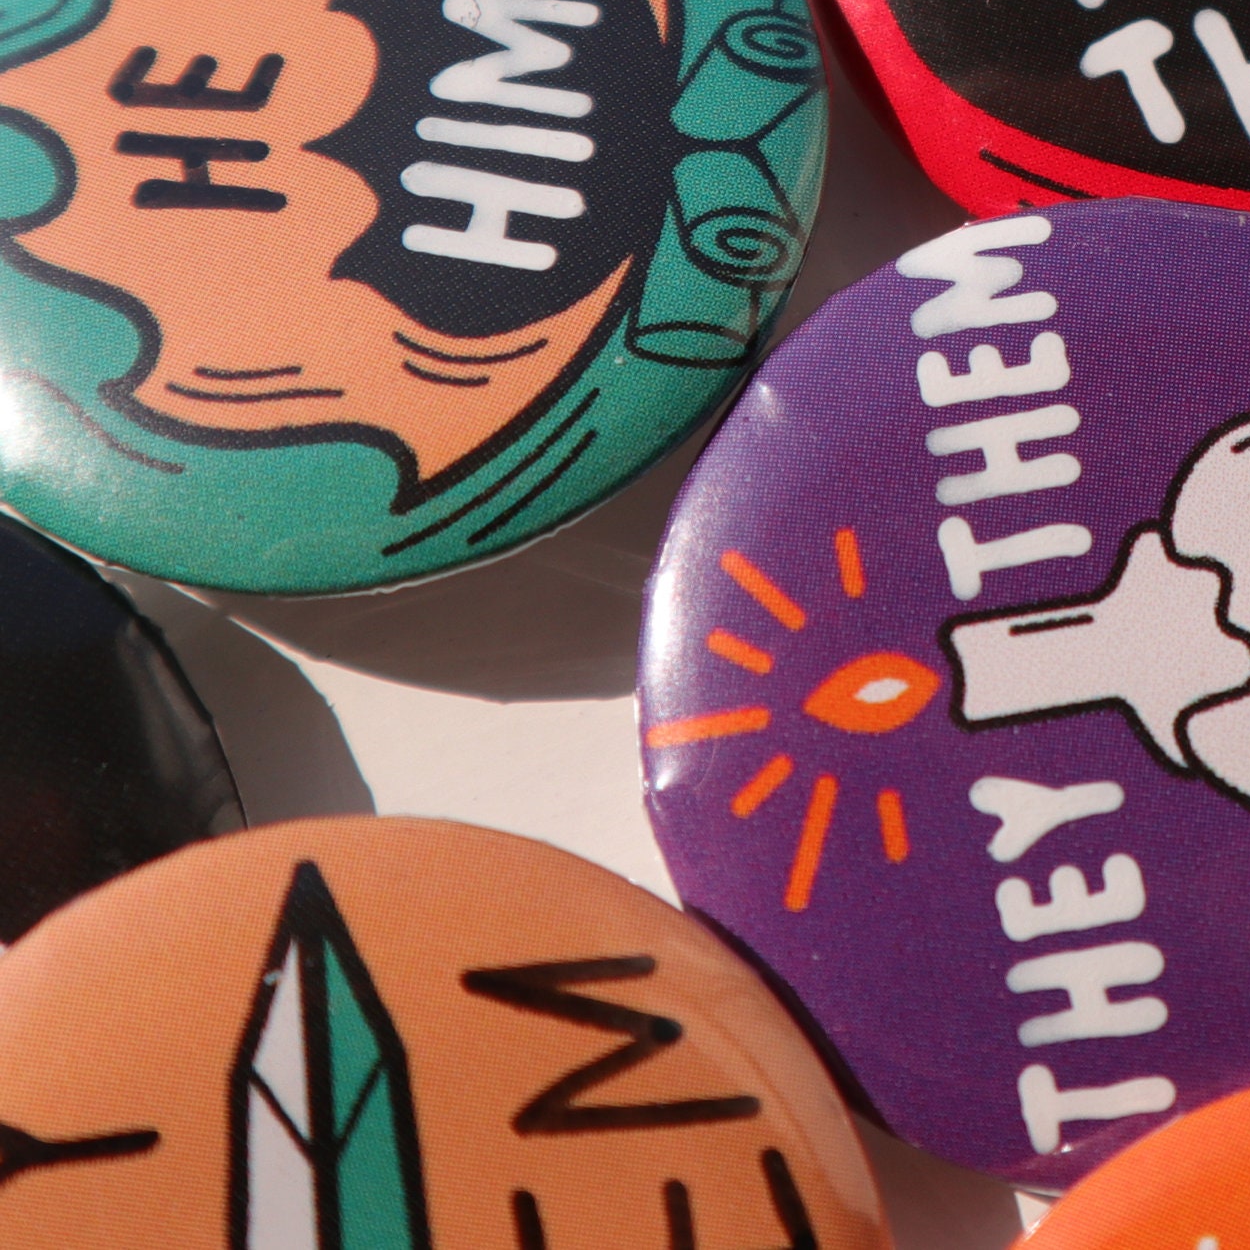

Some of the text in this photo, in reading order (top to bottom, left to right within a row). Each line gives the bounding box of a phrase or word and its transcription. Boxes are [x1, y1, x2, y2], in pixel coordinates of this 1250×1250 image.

[108, 45, 287, 213] HE
[896, 215, 1176, 1154] THEY THEM
